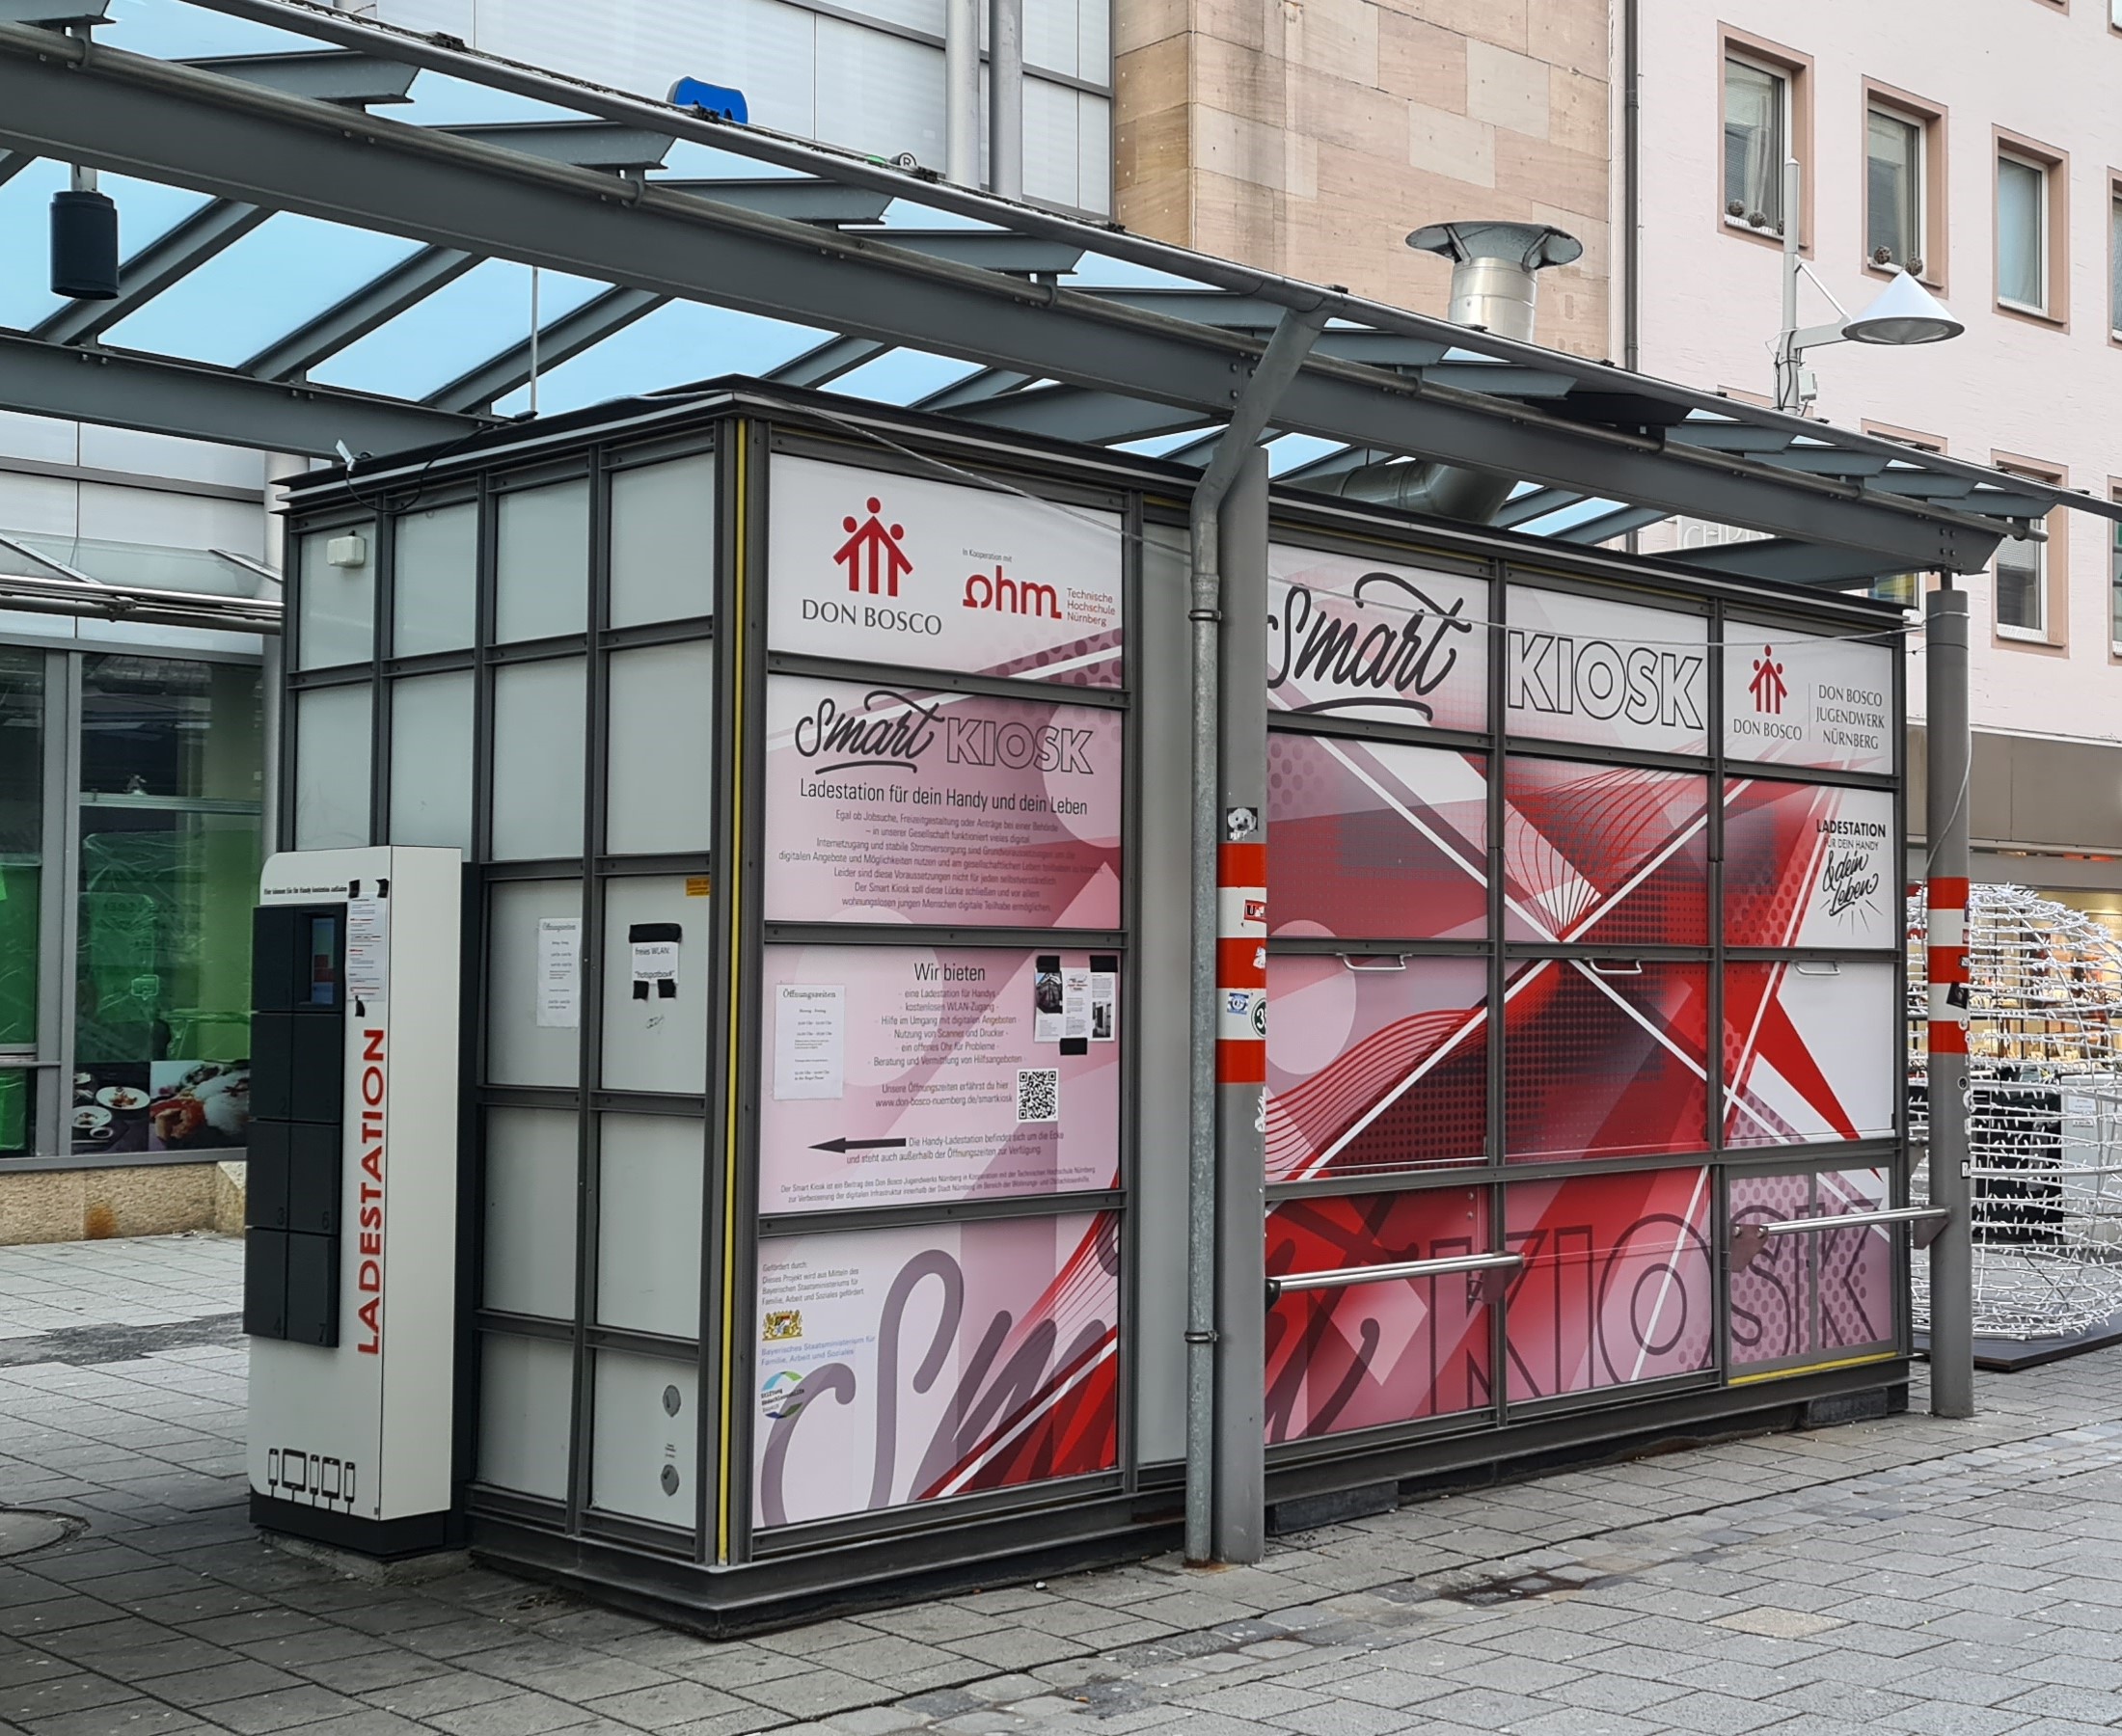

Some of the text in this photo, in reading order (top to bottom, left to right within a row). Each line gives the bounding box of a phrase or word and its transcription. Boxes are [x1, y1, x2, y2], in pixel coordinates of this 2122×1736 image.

[1066, 588, 1113, 604] Technische
[1067, 600, 1116, 616] Hochschule
[802, 598, 941, 636] DON BOSCO
[1067, 611, 1107, 627] Nürnberg
[1267, 572, 1704, 731] Smart KIOSK
[1818, 684, 1882, 707] DON BOSCO
[1816, 706, 1885, 729] JUGENDWERK
[795, 691, 1094, 774] Smart KIOSK
[1734, 719, 1802, 741] DON BOSCO
[1823, 727, 1878, 750] NÜRNBERG
[801, 778, 1087, 815] Ladestation für dein Handy und dein Leben
[836, 810, 851, 821] Egal
[1816, 819, 1886, 838] LADESTATION
[817, 838, 868, 851] Internetzugang
[871, 840, 884, 849] und
[1838, 839, 1853, 849] DEIN
[1856, 840, 1879, 850] HANDY
[779, 851, 912, 866] digitalen Angebote und Möglichkeiten
[834, 867, 855, 877] Leider
[858, 868, 872, 878] sind
[874, 869, 892, 879] diese
[855, 882, 867, 892] Der
[869, 882, 890, 892] Smart
[892, 884, 909, 893] Kiosk
[842, 897, 896, 908] wohnungslosen
[898, 898, 920, 909] jungen
[914, 963, 985, 981] Wir bieten
[905, 990, 919, 998] eine
[921, 989, 959, 998] Ladestation
[881, 1016, 897, 1024] Hilfe
[900, 1016, 908, 1024] im
[910, 1016, 937, 1026] Umgang
[952, 1016, 980, 1026] digitalen
[982, 1015, 1016, 1026] Angeboten
[894, 1030, 922, 1040] Nutzung
[902, 1043, 912, 1052] ein
[965, 1042, 995, 1050] Probleme
[874, 1057, 905, 1067] Beratung
[907, 1057, 919, 1065] und
[882, 1083, 906, 1093] Unsere
[908, 1081, 958, 1093] Öffnungszeiten
[987, 1081, 994, 1089] du
[996, 1080, 1008, 1089] hier
[909, 1137, 920, 1146] Die
[847, 1154, 860, 1164] und
[881, 1152, 897, 1161] auch
[899, 1151, 933, 1161] außerhalb
[948, 1148, 996, 1159] Öffnungszeiten
[357, 1028, 384, 1356] LADESTATION
[783, 1273, 802, 1283] Projekt
[786, 1294, 803, 1302] Arbeit
[804, 1293, 814, 1301] und
[762, 1344, 802, 1356] Bayerisches
[789, 1352, 811, 1362] Arbeit
[812, 1350, 825, 1359] und
